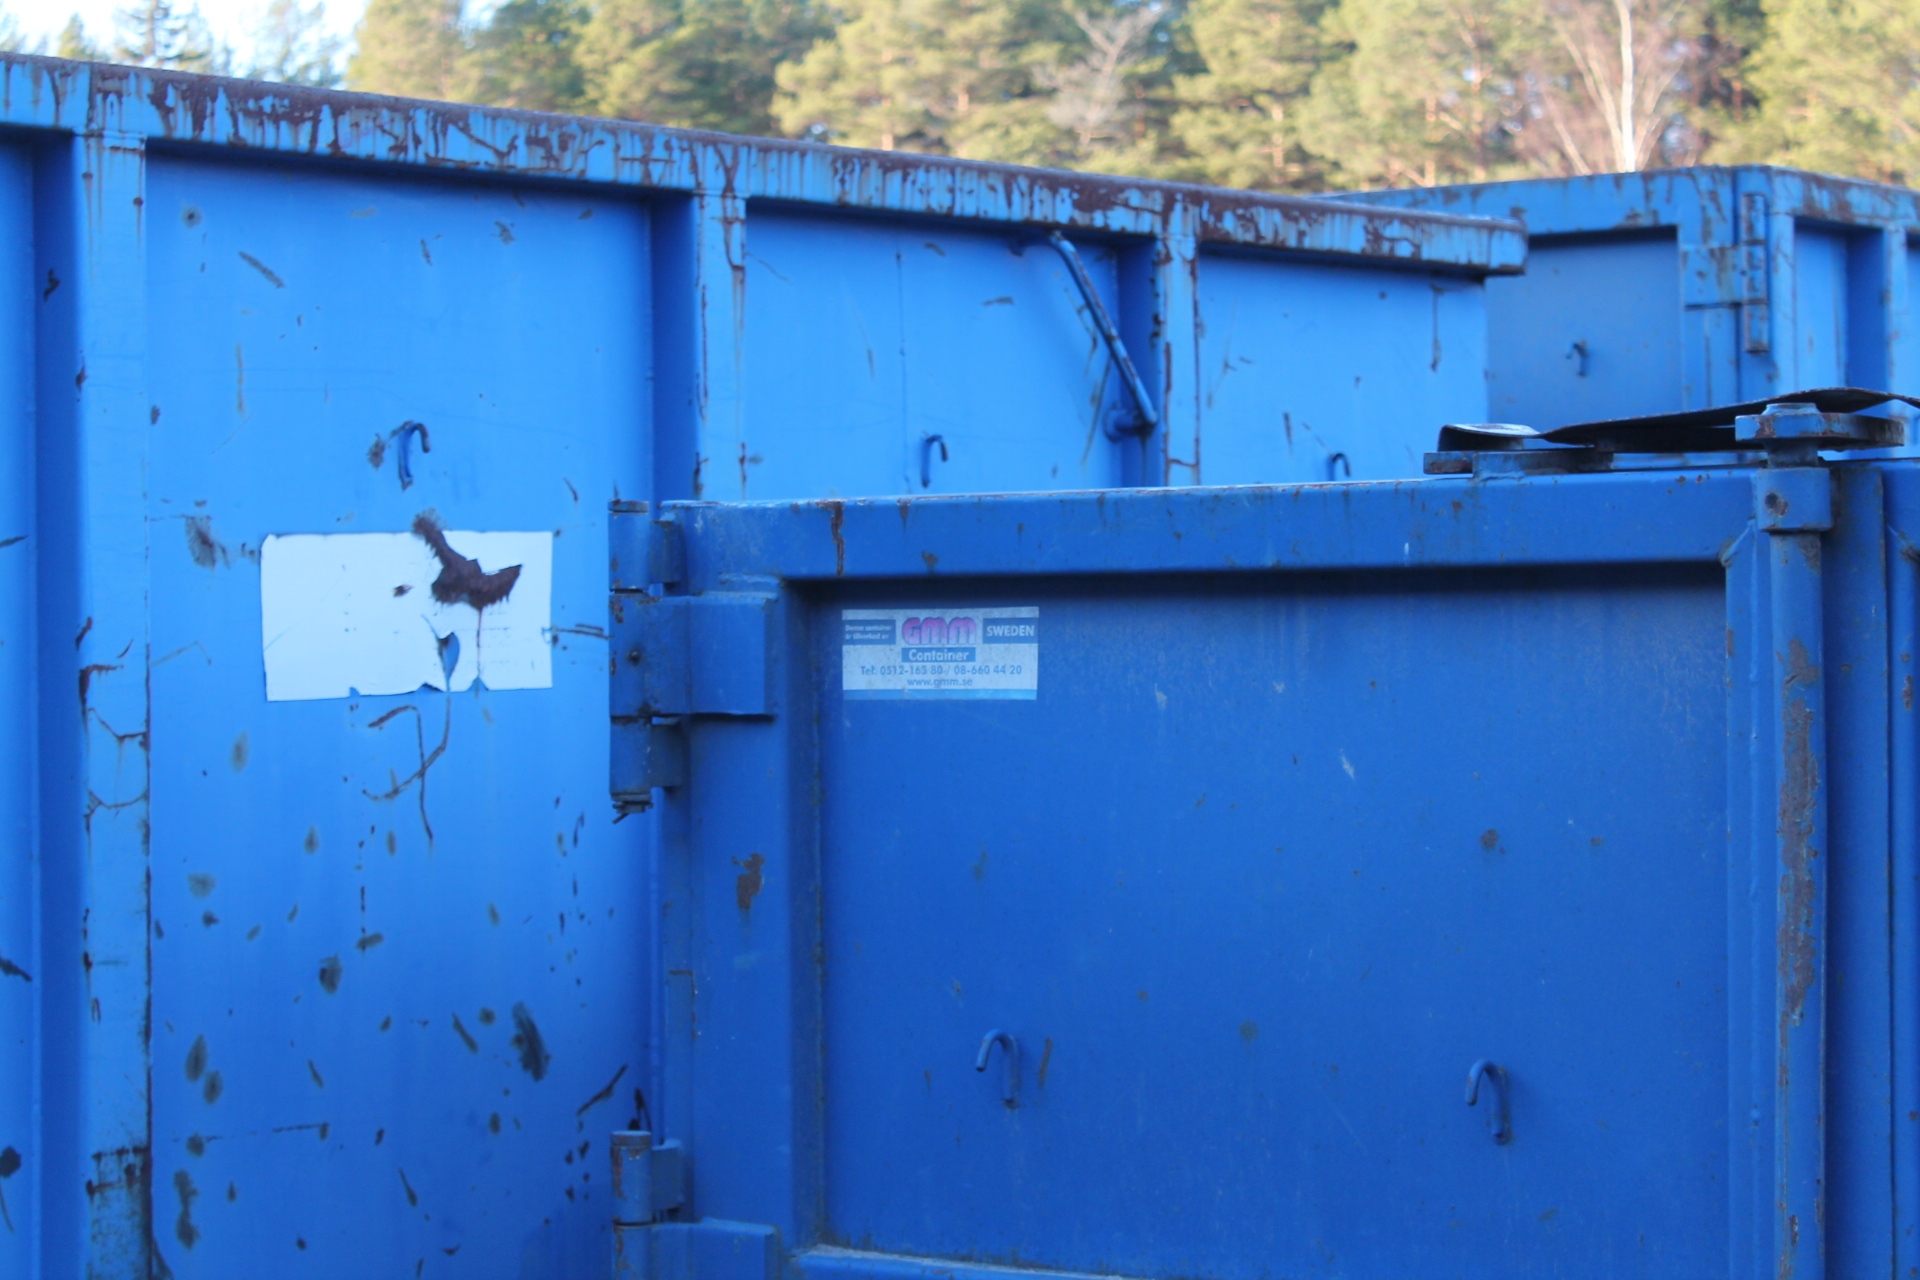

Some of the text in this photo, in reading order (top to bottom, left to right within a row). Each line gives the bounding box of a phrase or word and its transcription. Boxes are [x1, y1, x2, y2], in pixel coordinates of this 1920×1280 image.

[986, 625, 1035, 637] SWEDEN
[908, 648, 969, 662] Container
[880, 665, 927, 676] 0512-165
[930, 665, 943, 675] 80
[954, 665, 990, 675] 08-660
[993, 664, 1006, 675] 44
[1009, 665, 1022, 675] 20
[907, 678, 973, 687] www.gmm.se
